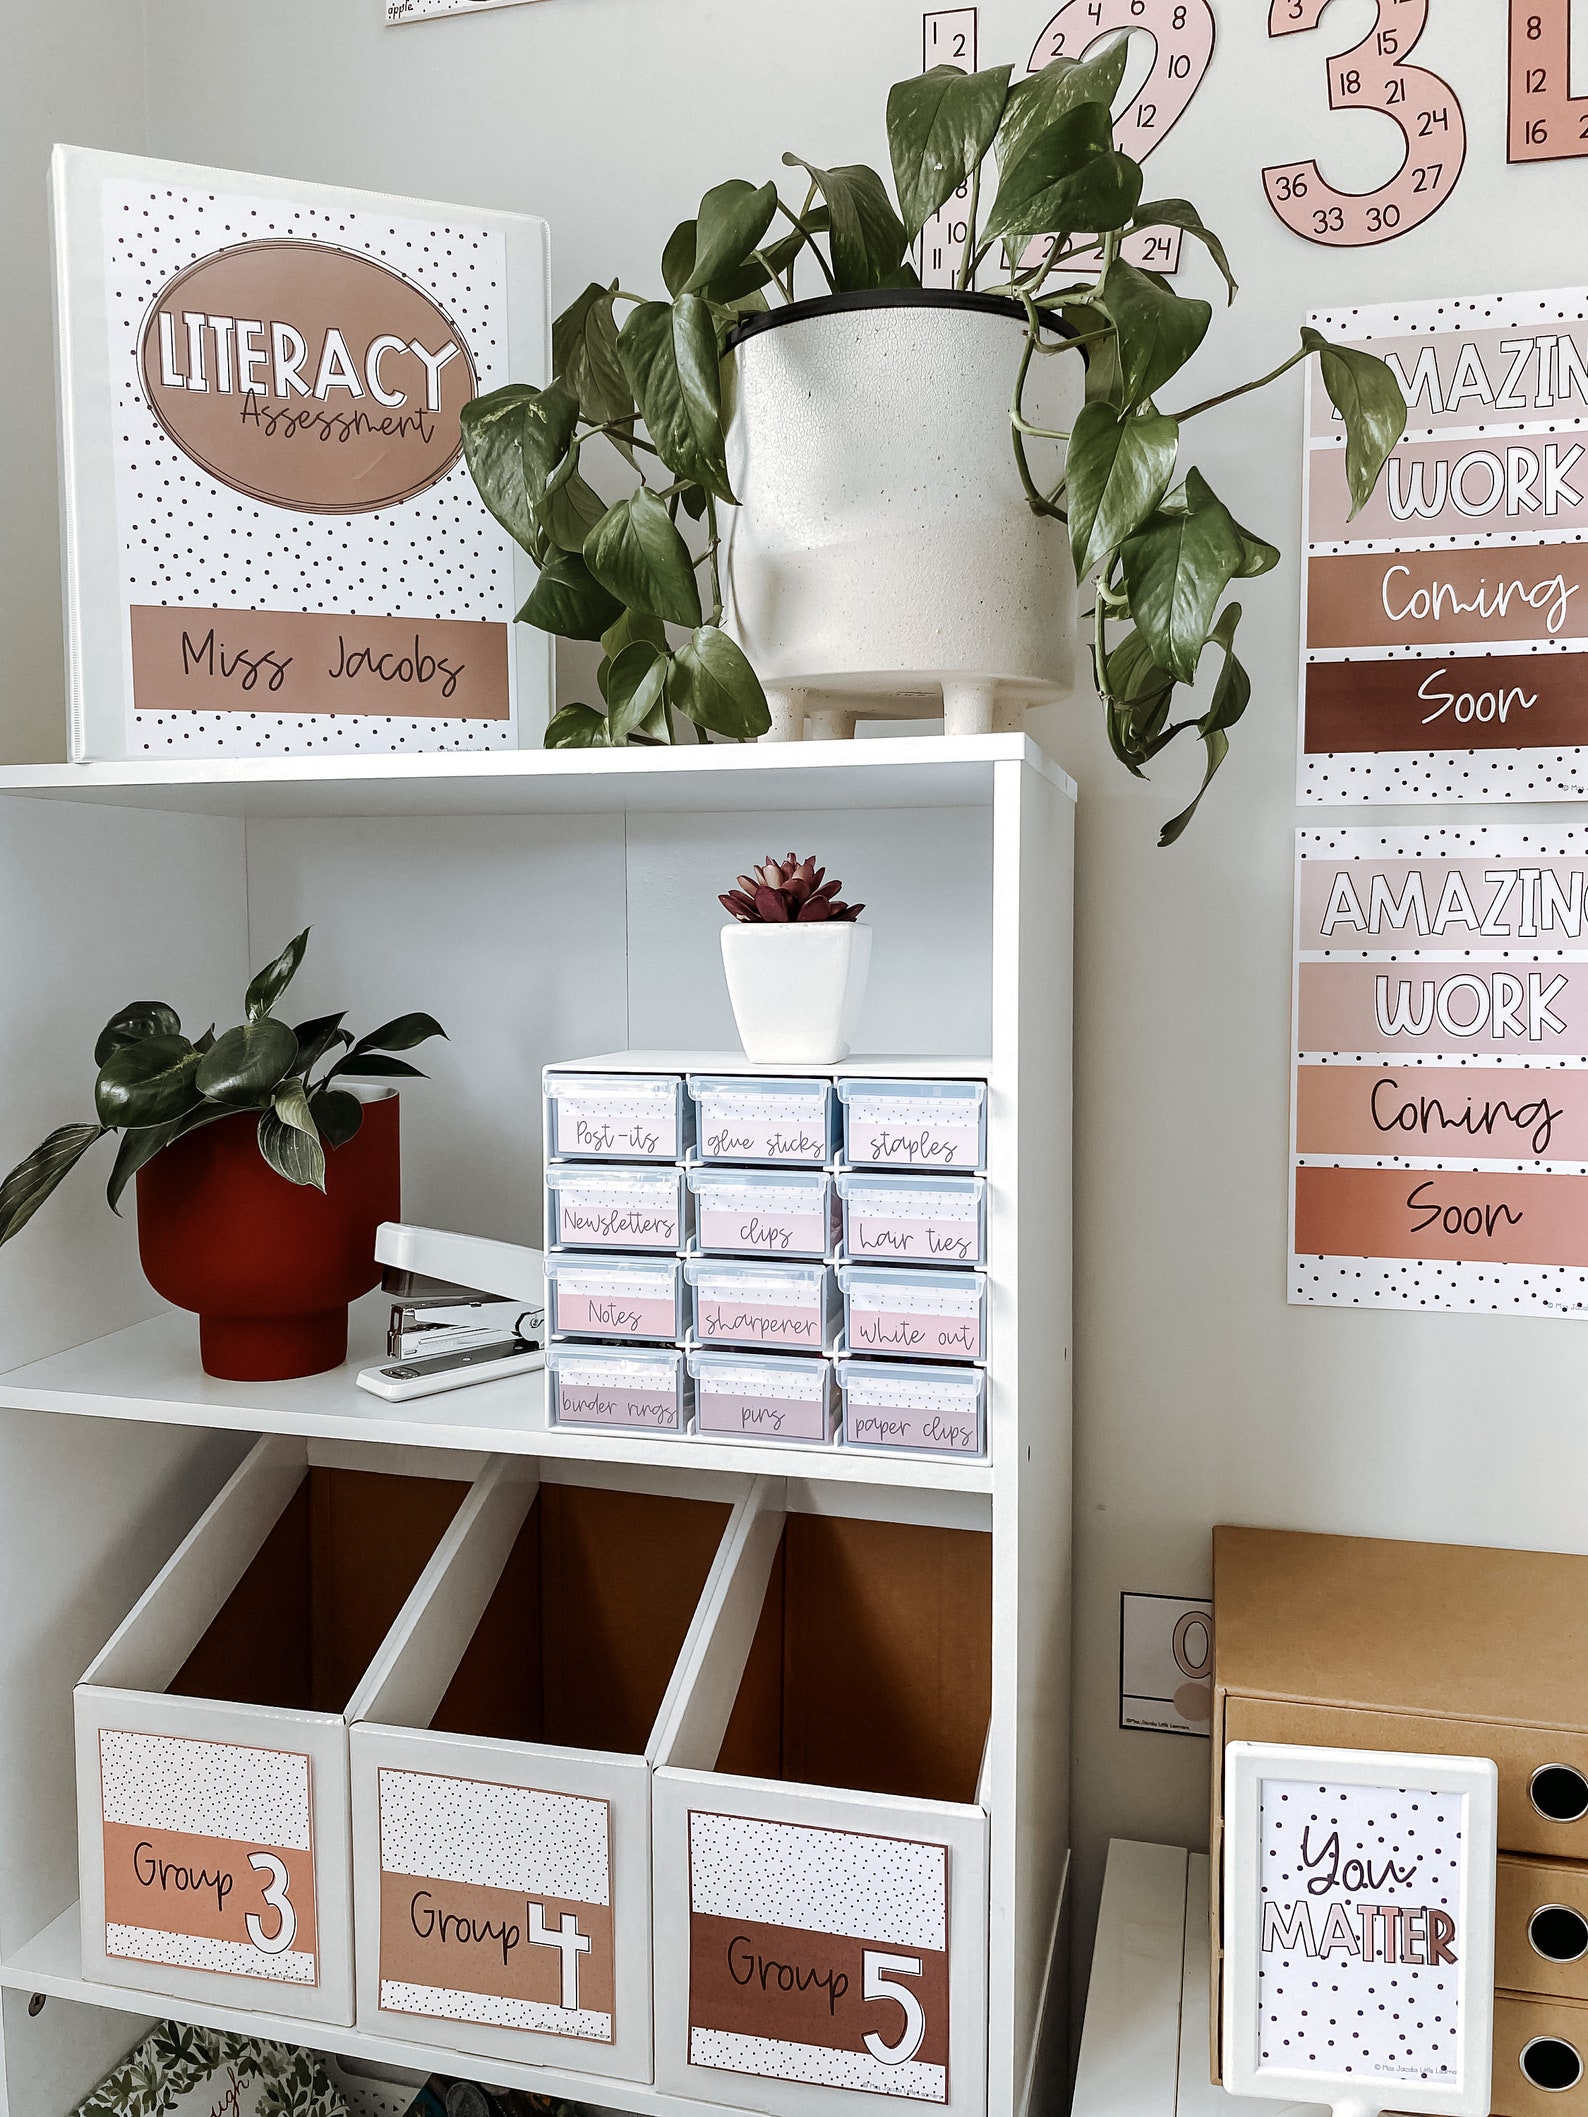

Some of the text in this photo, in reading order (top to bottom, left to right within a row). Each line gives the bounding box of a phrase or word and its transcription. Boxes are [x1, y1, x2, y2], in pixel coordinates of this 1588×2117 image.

[387, 1, 414, 19] apple
[1088, 2, 1102, 25] 4
[1130, 0, 1145, 16] 6
[1172, 6, 1187, 30] 8
[933, 21, 938, 45] 1
[1376, 28, 1398, 56] 15
[1526, 15, 1541, 41] 8
[953, 33, 966, 57] 2
[1050, 33, 1066, 57] 2
[1168, 54, 1191, 79] 10
[1526, 68, 1547, 94] 12
[1340, 70, 1361, 96] 18
[1384, 78, 1406, 105] 21
[1136, 104, 1157, 128] 12
[1416, 107, 1448, 137] 24
[1525, 119, 1548, 145] 16
[1275, 173, 1308, 201] 36
[1411, 163, 1443, 193] 27
[948, 221, 968, 245] 10
[1312, 203, 1401, 235] 33 30
[933, 248, 942, 270] 11
[1142, 237, 1172, 261] 24
[158, 310, 461, 413] LITERACY
[1332, 334, 1588, 421] MAZIN
[240, 387, 435, 444] Assessment
[1388, 443, 1586, 521] WORK
[1382, 565, 1580, 634] Coming
[182, 628, 465, 698] Miss Jacobs
[1417, 668, 1539, 724] Soon
[1320, 868, 1588, 939] AMAZIN
[1375, 972, 1569, 1041] WORK
[1371, 1078, 1563, 1154] Coming
[577, 1120, 659, 1153] Post-its
[707, 1129, 824, 1158] glue sticks
[870, 1131, 958, 1162] staples
[564, 1208, 675, 1239] Newsletters
[1407, 1181, 1523, 1237] Soon
[740, 1218, 793, 1249] clips
[859, 1223, 972, 1259] hair ties
[588, 1299, 642, 1332] Notes
[705, 1306, 818, 1339] sharpener
[860, 1317, 975, 1350] white out
[562, 1391, 678, 1425] binder rings
[741, 1405, 786, 1431] pins
[855, 1416, 973, 1447] paper clips
[1302, 1825, 1417, 1895] You
[134, 1841, 297, 1955] Group 3
[1262, 1900, 1459, 1966] MATTER
[411, 1890, 592, 2011] Group 4
[728, 1936, 926, 2066] Group 5
